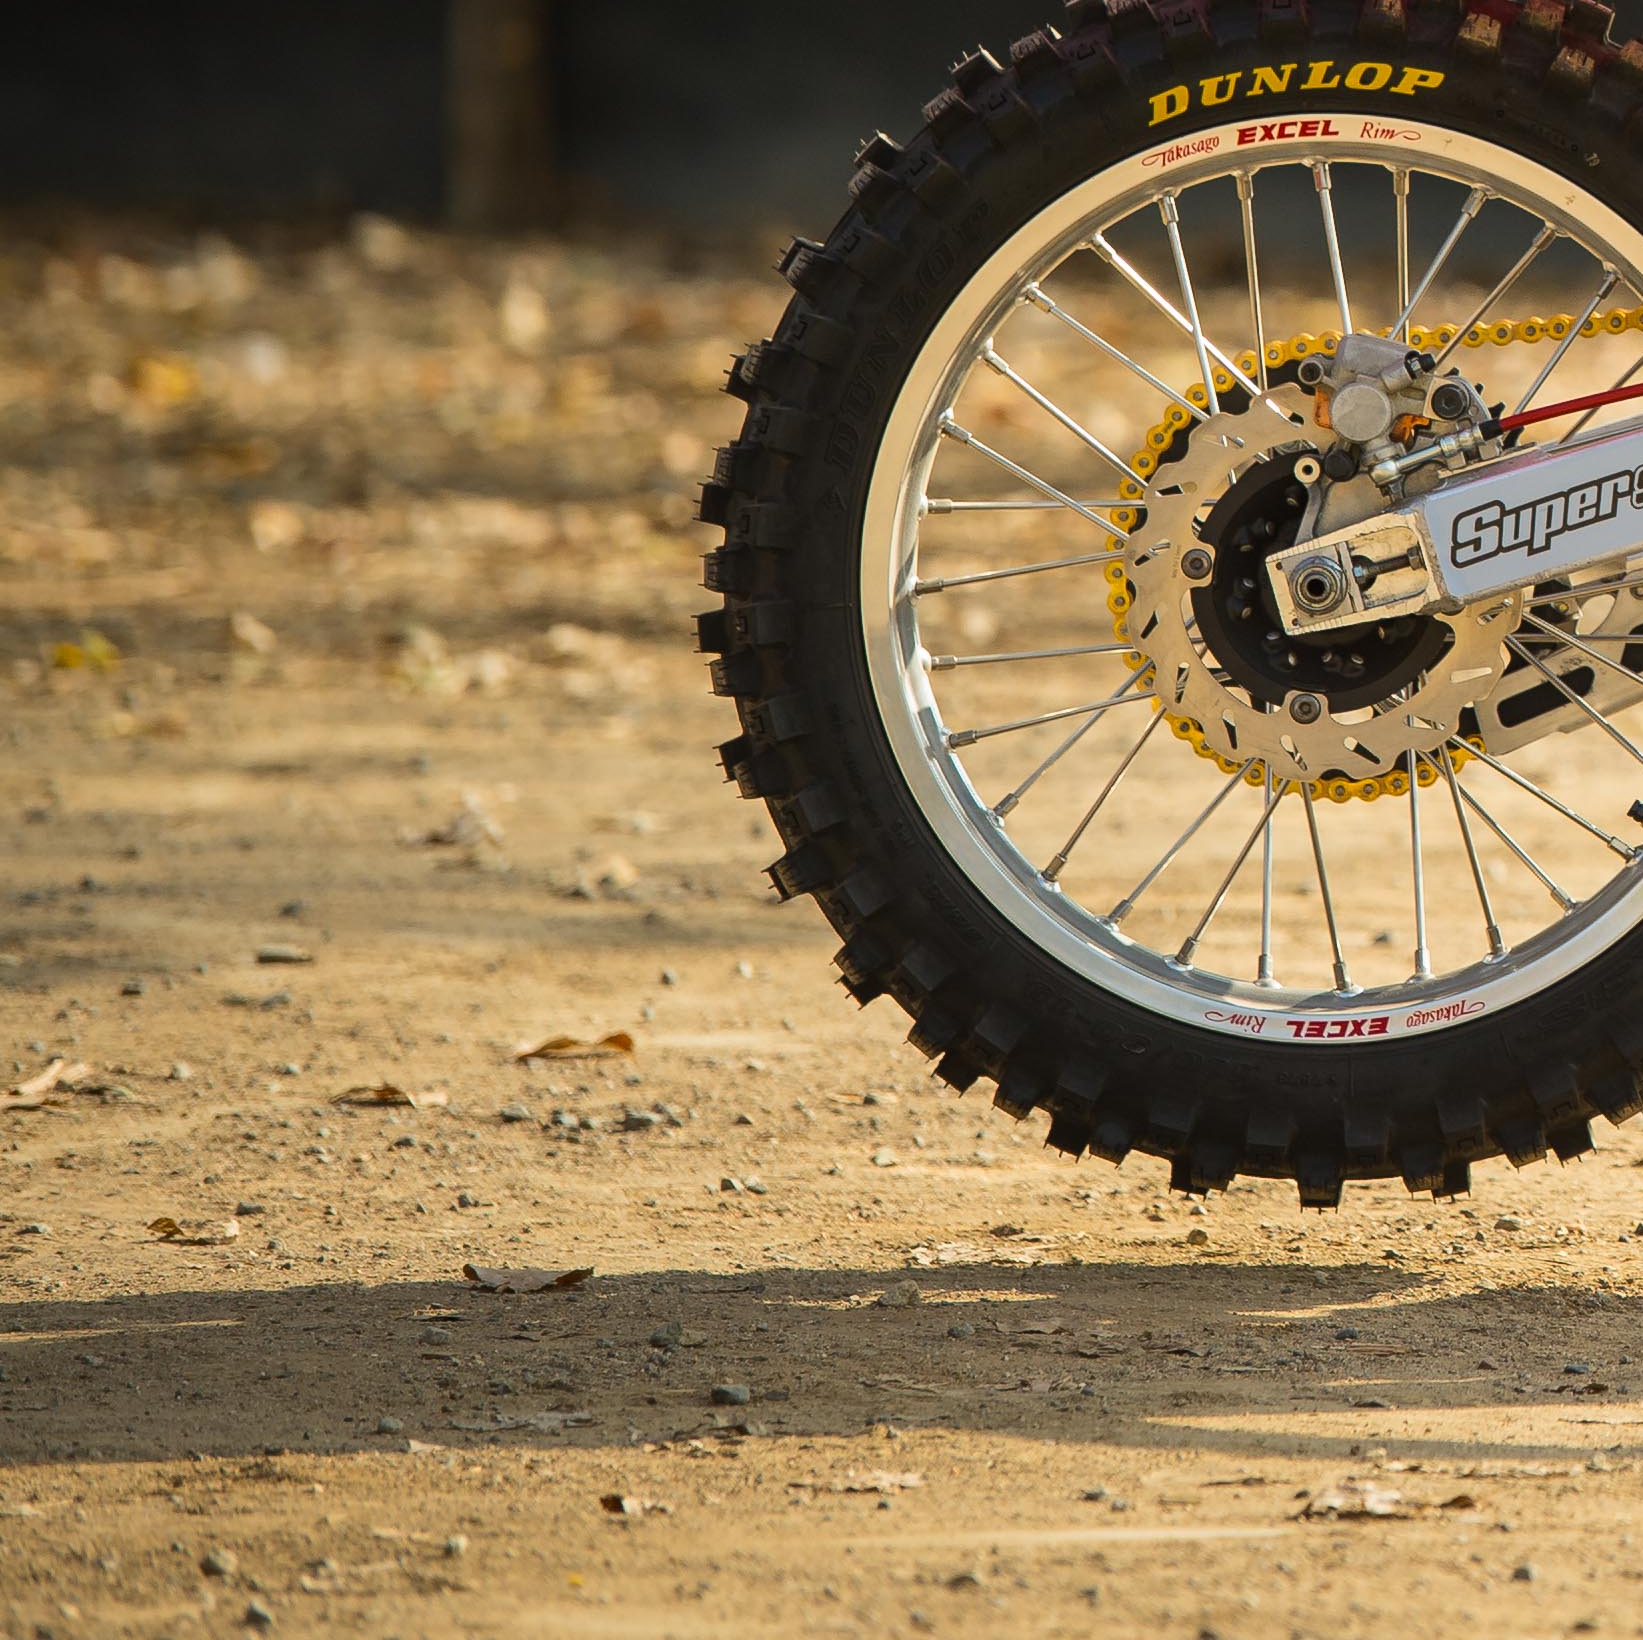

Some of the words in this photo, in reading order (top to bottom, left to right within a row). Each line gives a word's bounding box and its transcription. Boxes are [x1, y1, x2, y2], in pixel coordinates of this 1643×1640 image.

[1148, 60, 1445, 127] DUNLOP
[1236, 120, 1339, 146] EXCEL
[1360, 121, 1412, 141] Rim
[1286, 1016, 1390, 1038] EXCEL
